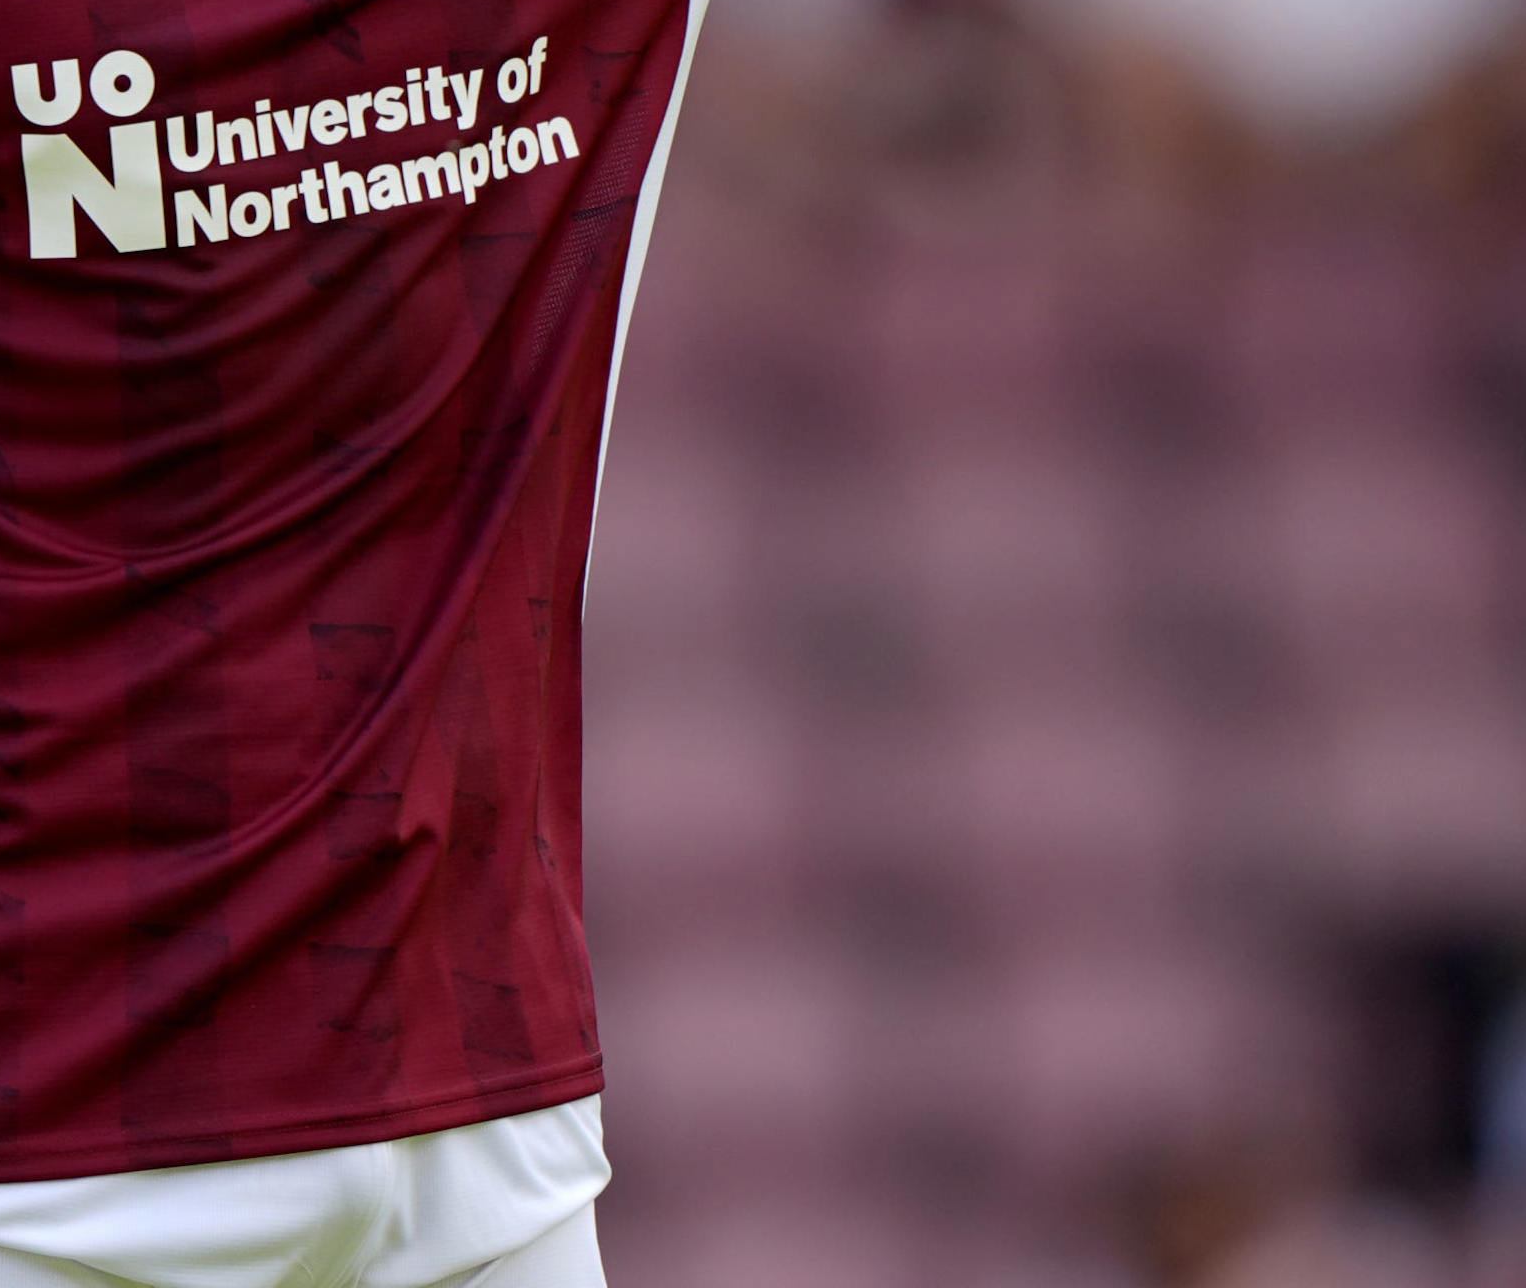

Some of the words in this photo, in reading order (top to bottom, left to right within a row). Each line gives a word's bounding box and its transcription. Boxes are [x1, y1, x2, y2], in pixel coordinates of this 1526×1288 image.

[166, 66, 484, 173] University
[497, 36, 548, 104] of
[21, 120, 166, 259] N
[174, 116, 580, 248] Northampton
